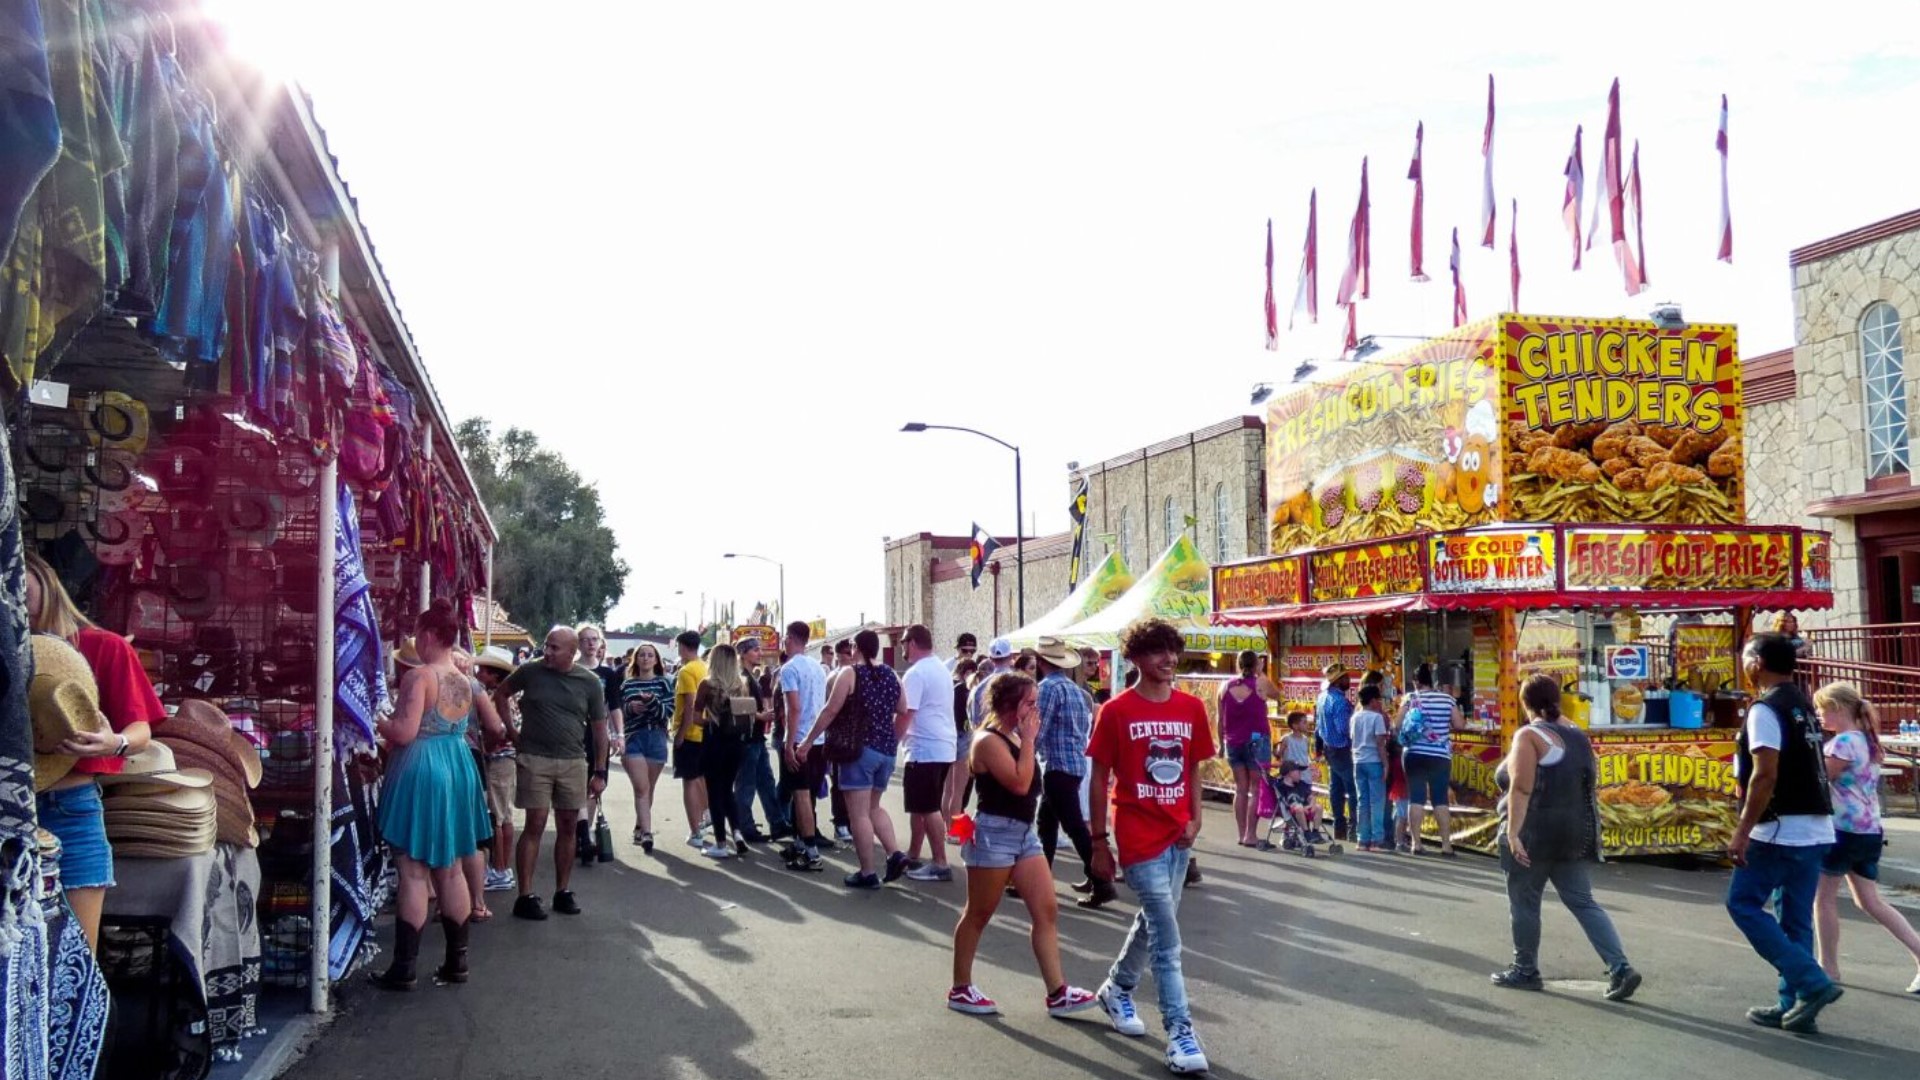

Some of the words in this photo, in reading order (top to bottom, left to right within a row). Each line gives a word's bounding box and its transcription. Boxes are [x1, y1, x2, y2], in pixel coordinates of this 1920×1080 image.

[1517, 330, 1717, 383] CHICKEN
[1274, 393, 1340, 462] FRESH
[1346, 371, 1397, 425] CUT
[1403, 356, 1487, 411] FRIES
[1514, 377, 1722, 433] TENDERS
[1445, 542, 1469, 557] ICE
[1476, 540, 1525, 555] COLD
[1576, 541, 1656, 578] FRESH
[1661, 541, 1706, 578] CUT
[1713, 541, 1780, 579] FRIES
[1343, 556, 1383, 588] CHEESE
[1385, 553, 1420, 583] FRIES
[1434, 558, 1488, 582] BOTTLED
[1494, 555, 1544, 579] WATER
[1222, 574, 1257, 601] CHICKEN
[1257, 570, 1297, 598] TENDERS
[1214, 634, 1268, 652] LEMO
[1287, 655, 1313, 669] FRESH
[1316, 655, 1334, 668] CUT
[1614, 657, 1641, 666] PEPSI
[1452, 755, 1497, 801] NDERS
[1635, 752, 1738, 795] TENDERS
[1624, 827, 1653, 847] CUT
[1658, 825, 1702, 845] FRIES
